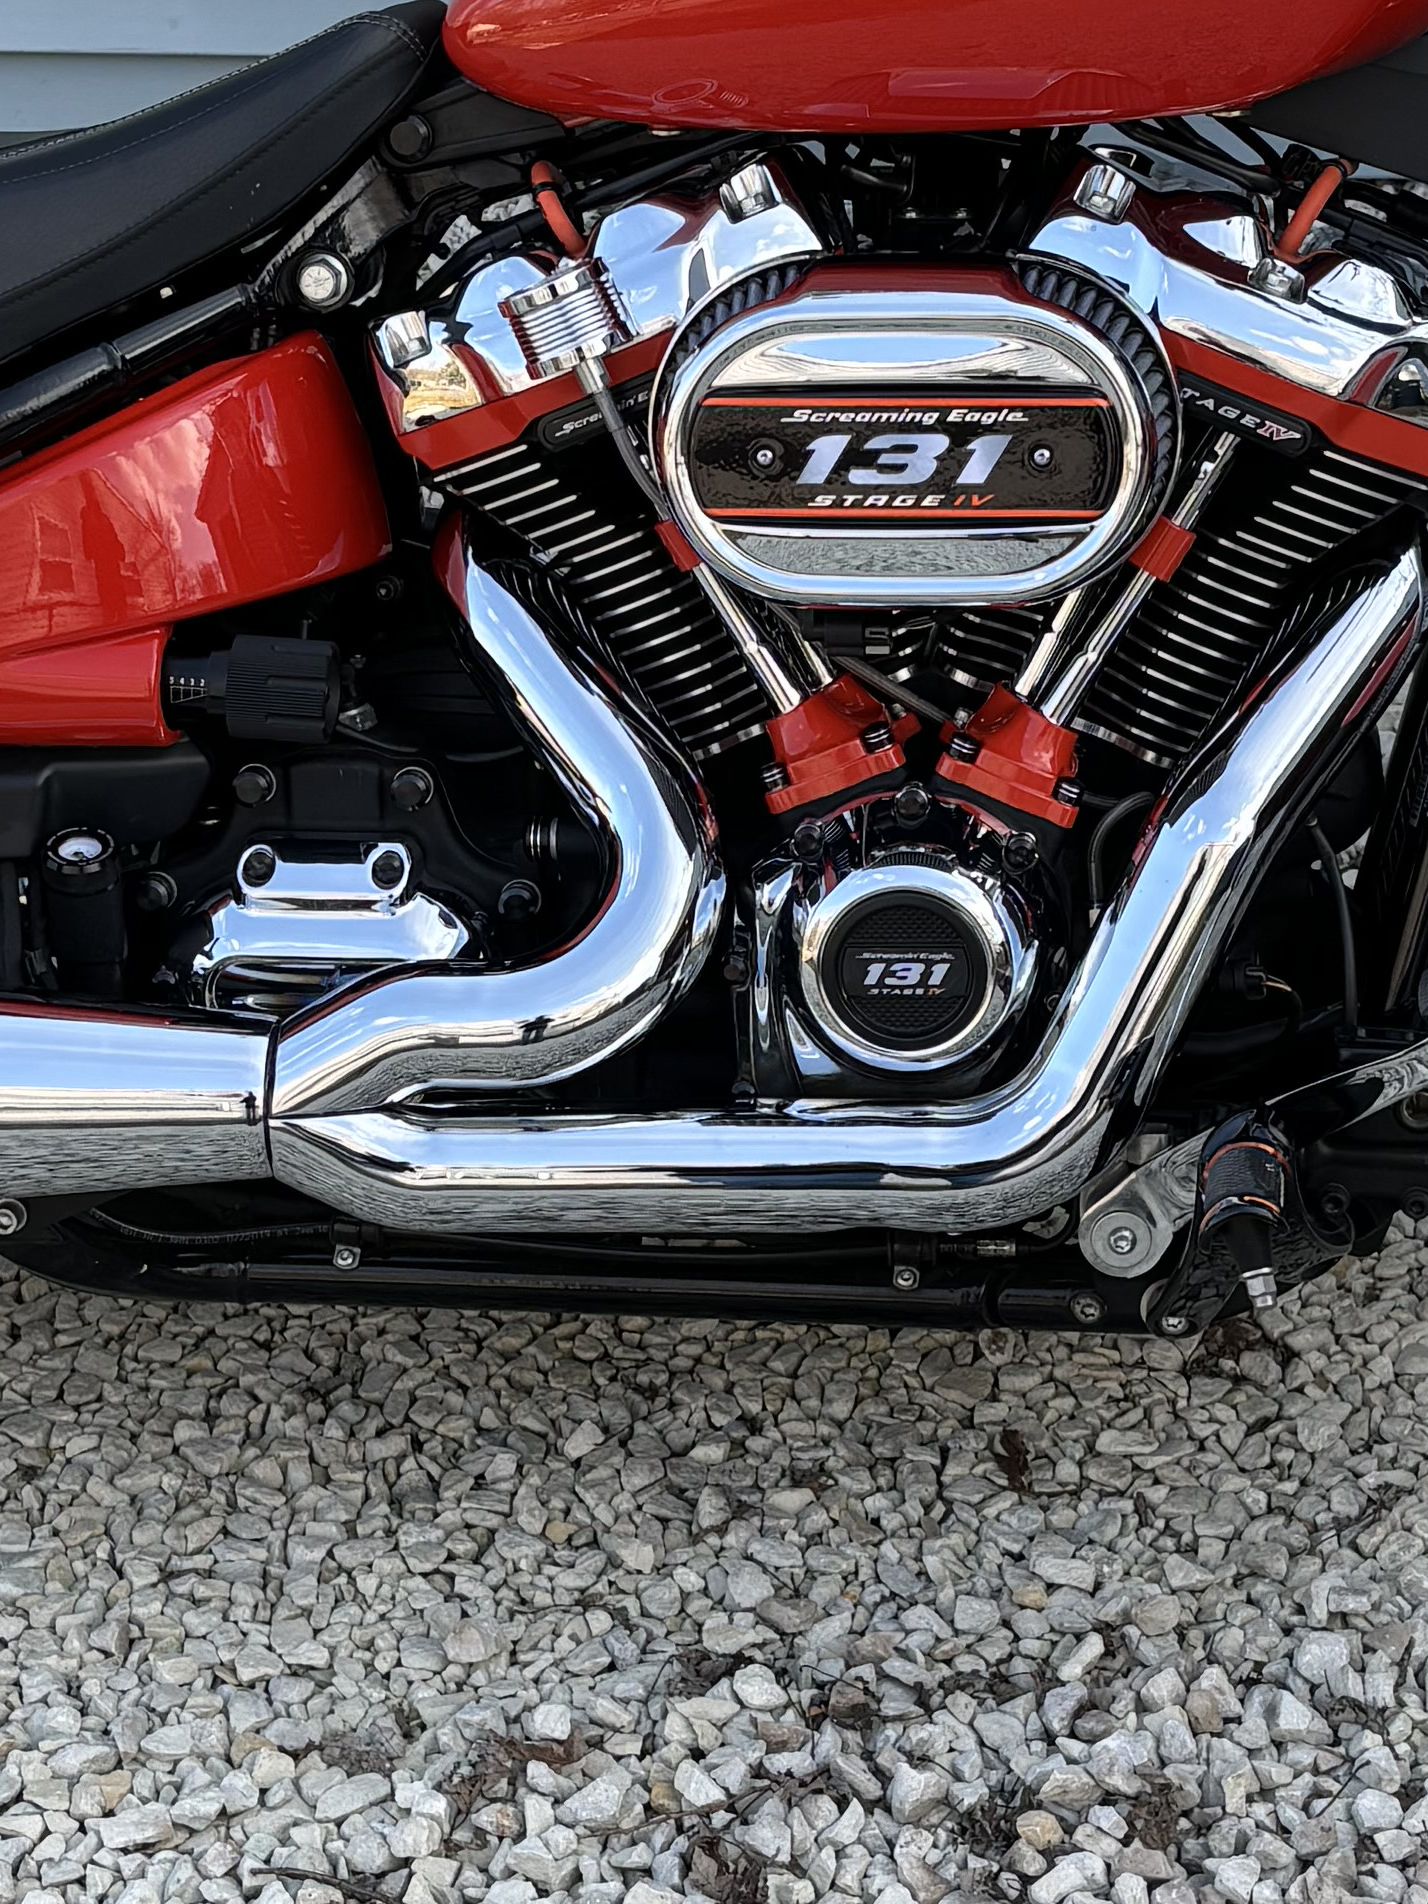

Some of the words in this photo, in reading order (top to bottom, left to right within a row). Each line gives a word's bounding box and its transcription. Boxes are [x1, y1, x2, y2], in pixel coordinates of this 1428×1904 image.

[780, 409, 938, 426] Screaming
[946, 409, 1030, 426] Eagle
[1257, 420, 1302, 441] IV
[795, 434, 1013, 486] 131
[808, 494, 946, 507] STAGE
[953, 494, 995, 507] IV
[863, 962, 951, 985] 131
